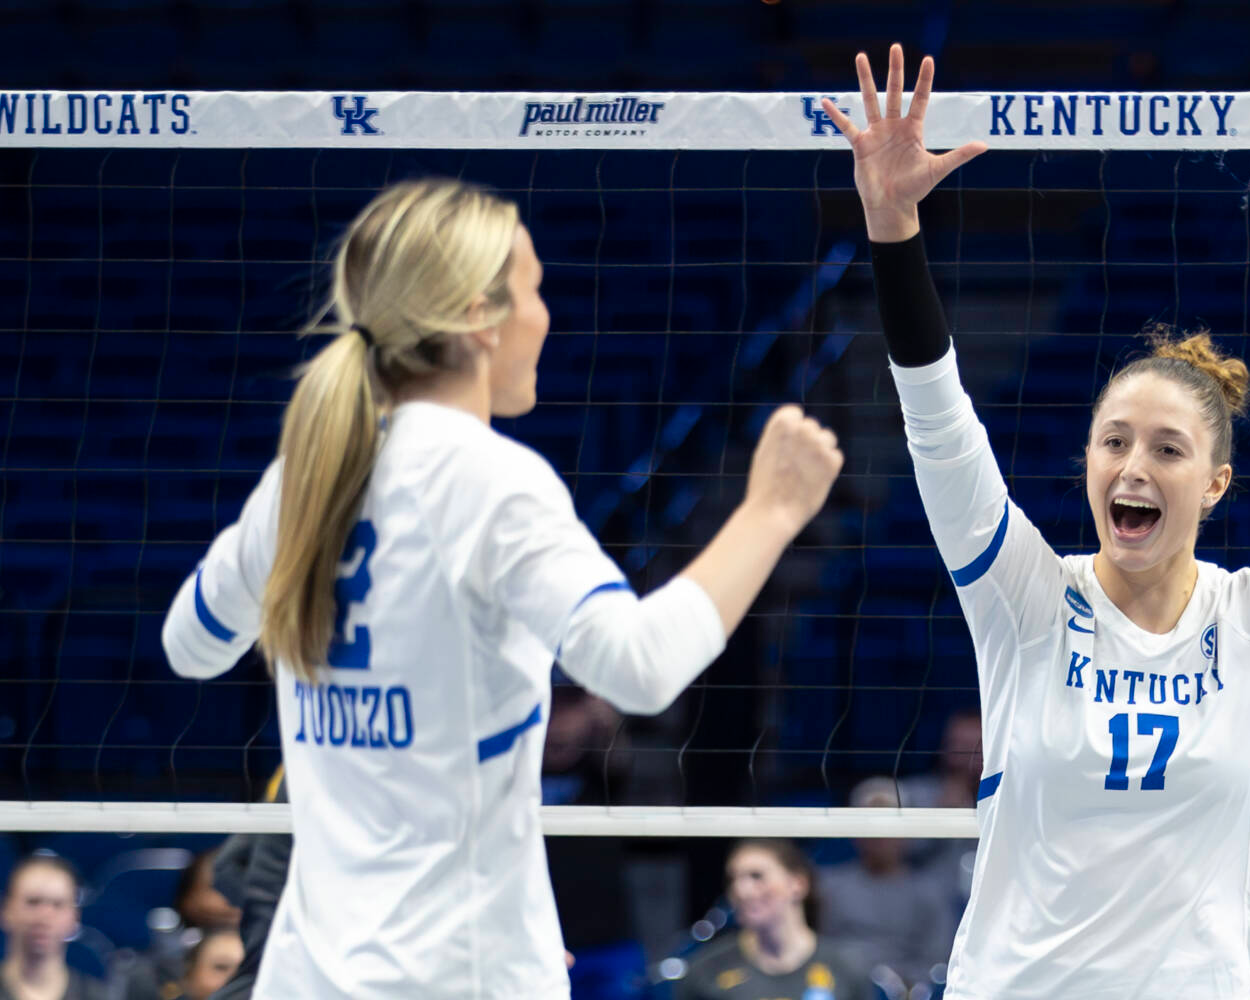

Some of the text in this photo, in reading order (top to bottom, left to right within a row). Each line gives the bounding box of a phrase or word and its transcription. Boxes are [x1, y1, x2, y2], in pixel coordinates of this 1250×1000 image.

[0, 93, 190, 135] WILDCATS
[332, 96, 381, 136] UK
[519, 96, 665, 136] paul miller
[535, 129, 647, 137] MOTOR COMPANY
[989, 94, 1236, 136] KENTUCKY
[327, 519, 377, 670] 2
[1104, 713, 1180, 791] 17
